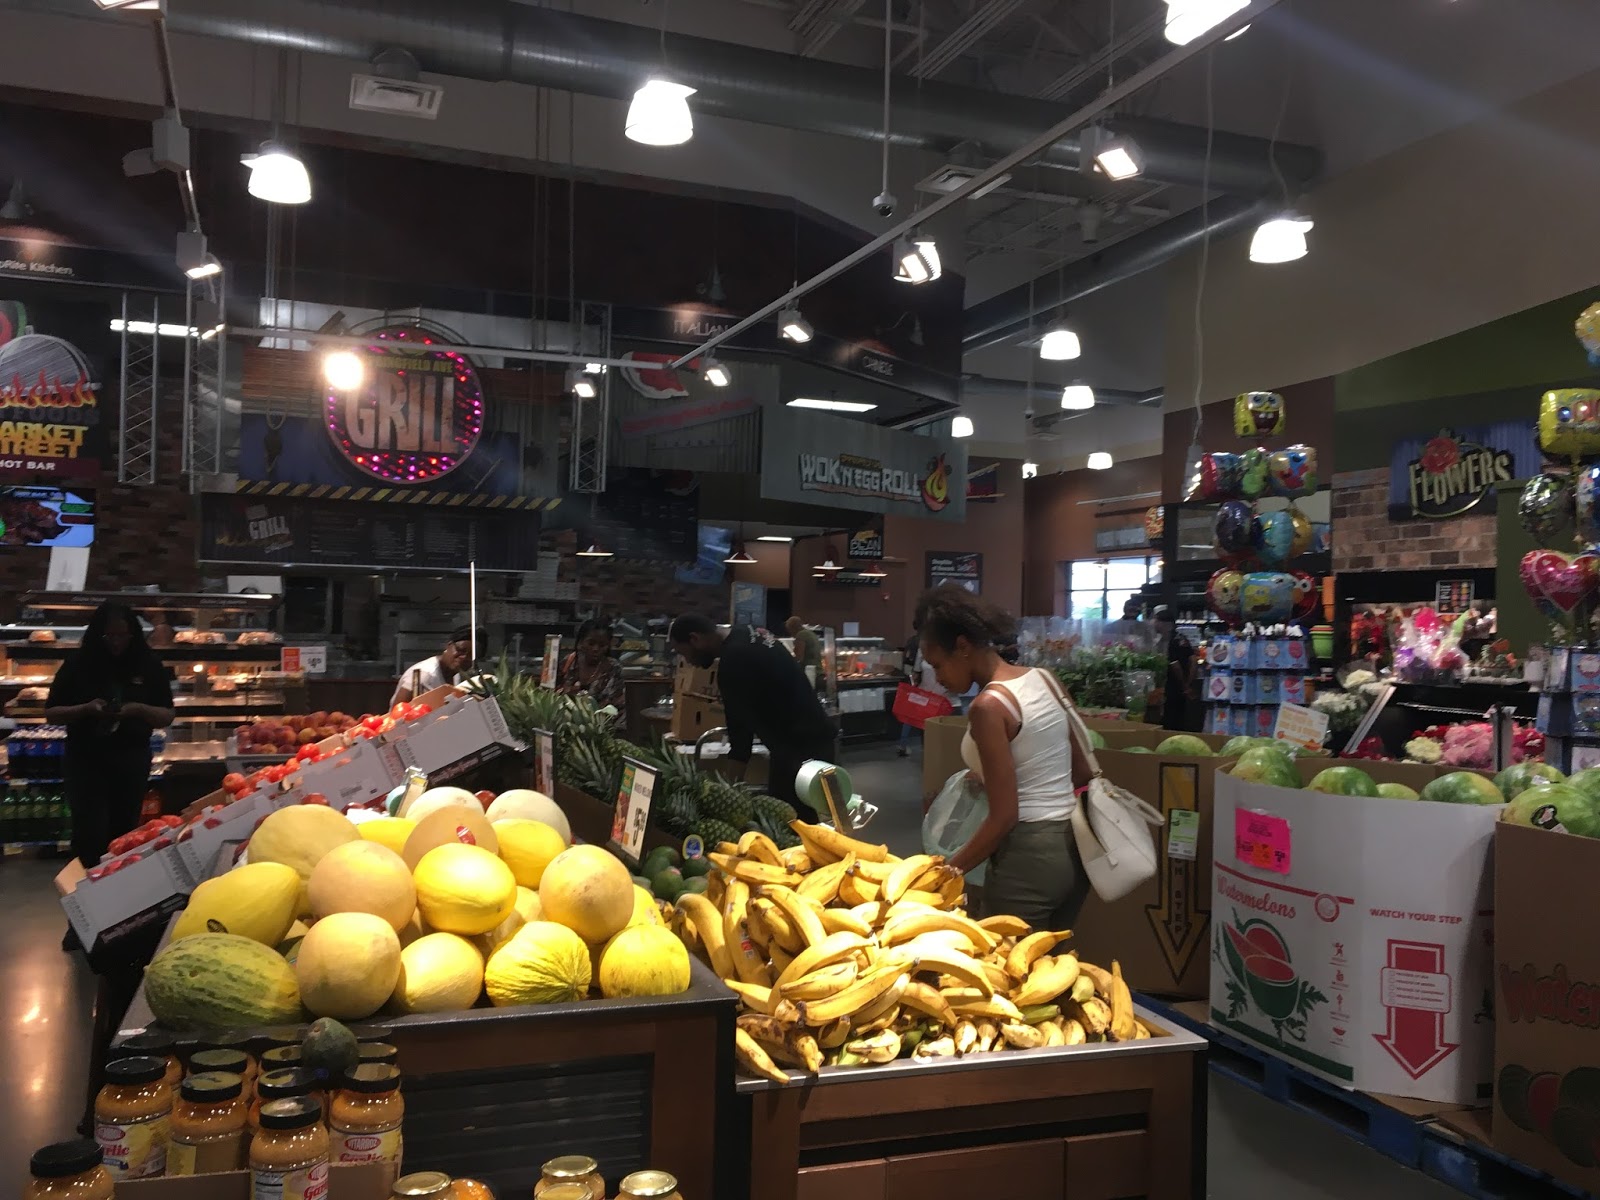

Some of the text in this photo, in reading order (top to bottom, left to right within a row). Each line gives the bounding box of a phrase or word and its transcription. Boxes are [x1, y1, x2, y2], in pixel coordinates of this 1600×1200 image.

[345, 371, 459, 453] GRILL
[0, 421, 89, 447] ARKET
[0, 438, 79, 459] TREET
[26, 461, 55, 471] BAR
[799, 454, 840, 484] WOK
[855, 469, 881, 492] EGG
[881, 468, 921, 497] ROLL
[1409, 451, 1511, 508] FLOWERS
[1217, 873, 1296, 919] Watermelons
[1369, 908, 1463, 925] WATCH YOUR STEP
